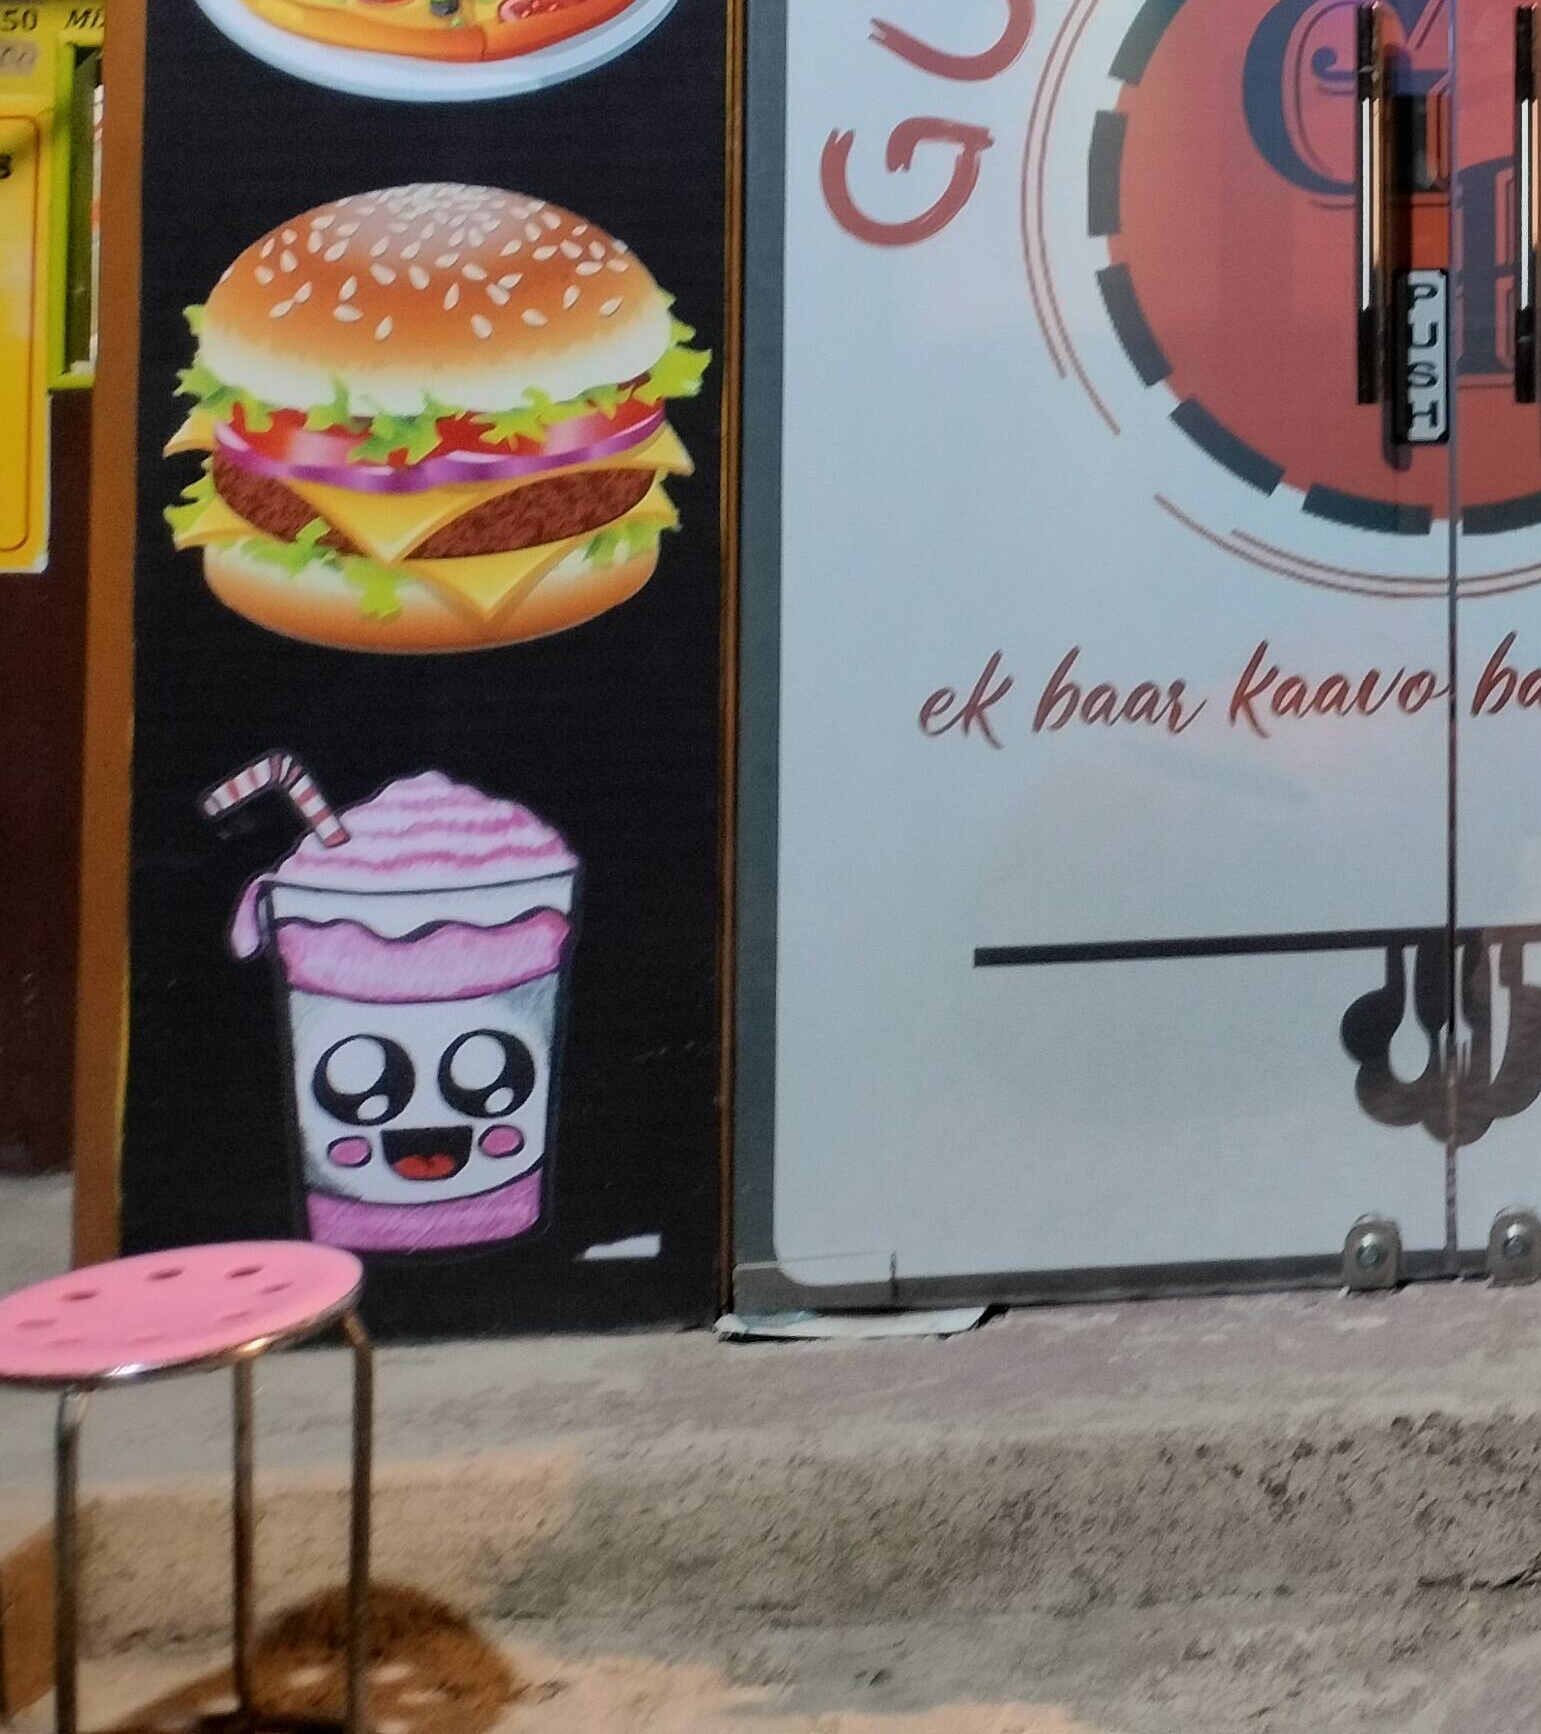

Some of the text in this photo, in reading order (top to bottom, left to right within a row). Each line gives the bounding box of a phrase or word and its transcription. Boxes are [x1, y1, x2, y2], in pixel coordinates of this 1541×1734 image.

[1408, 283, 1438, 428] PUSH
[917, 651, 1014, 749] ek
[1030, 646, 1206, 737] baar
